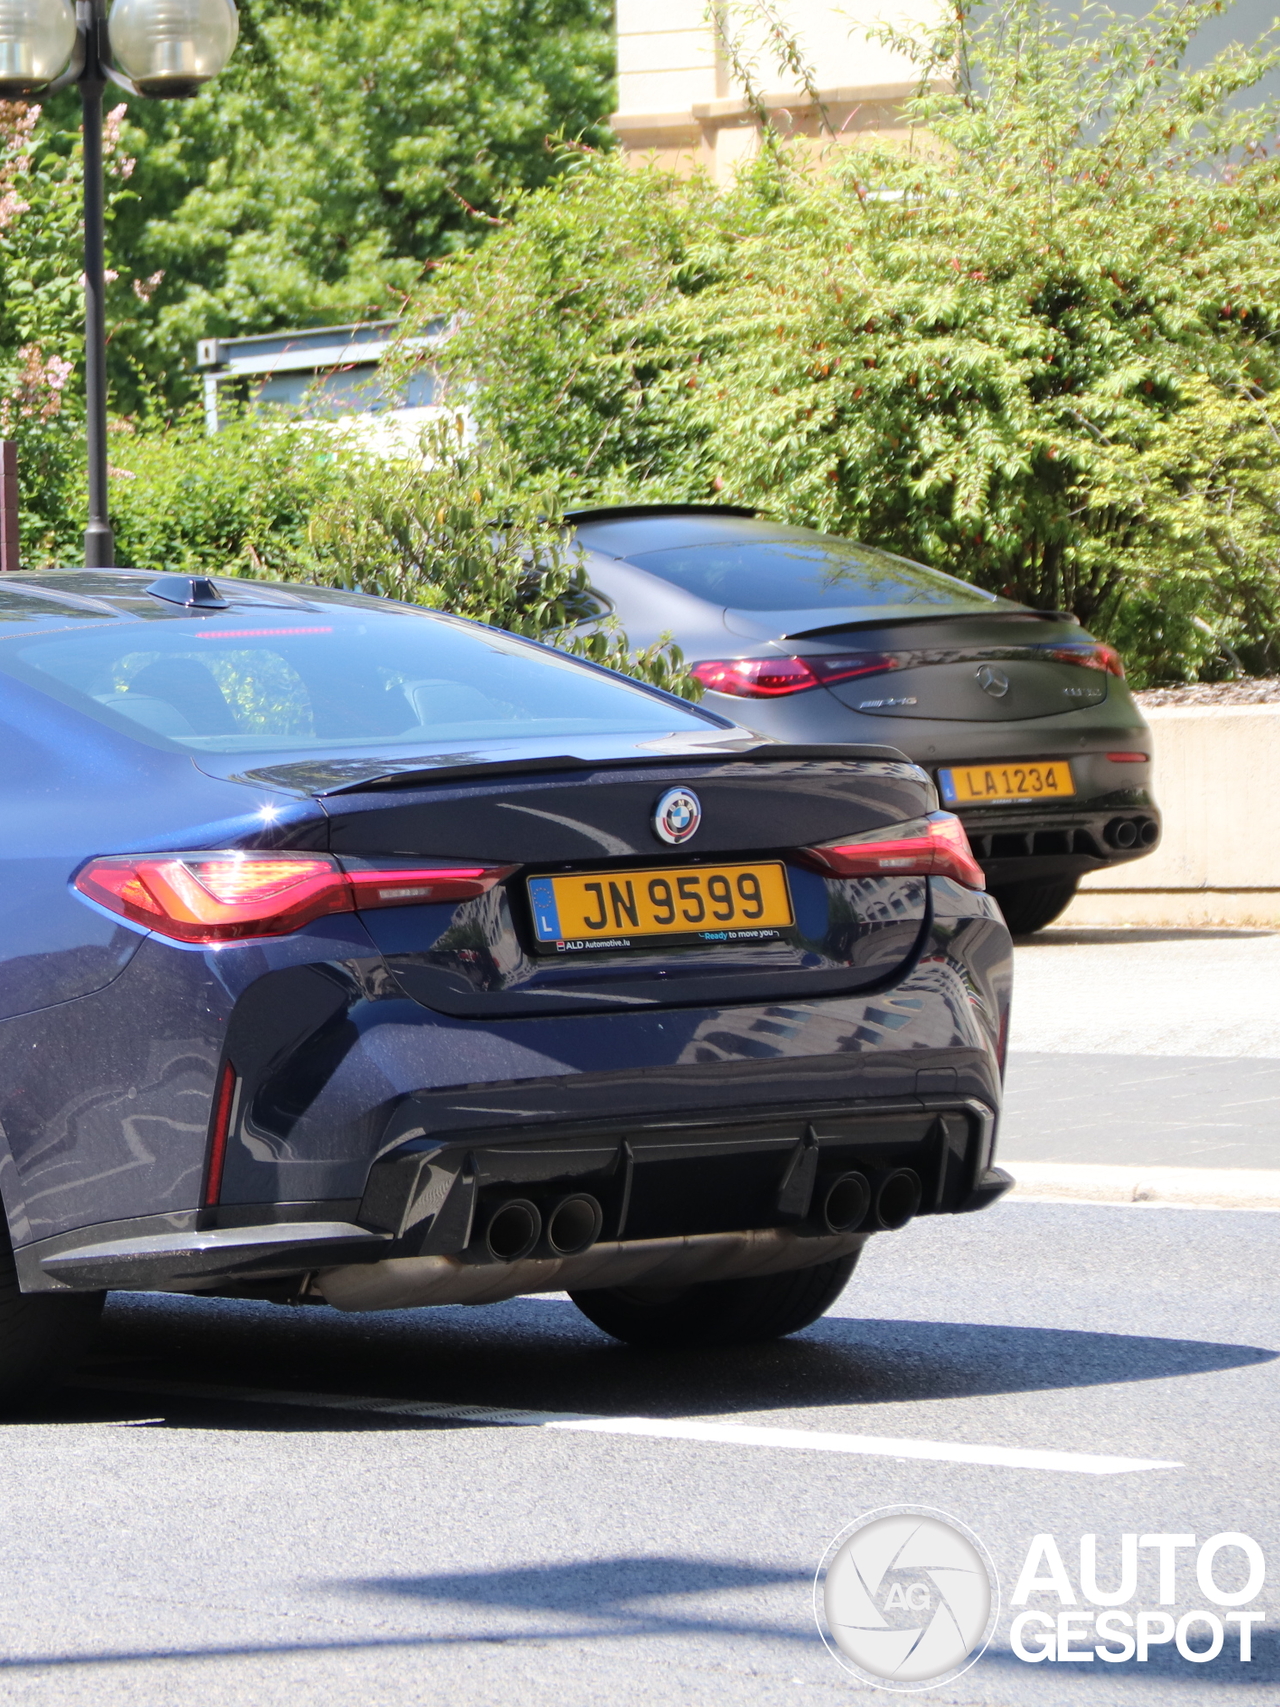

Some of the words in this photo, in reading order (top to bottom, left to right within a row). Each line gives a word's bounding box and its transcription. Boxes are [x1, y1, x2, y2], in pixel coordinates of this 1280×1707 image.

[583, 881, 640, 930] JN
[648, 873, 765, 925] 9599
[541, 916, 553, 932] L
[704, 931, 728, 940] Ready
[738, 930, 759, 938] move
[759, 929, 774, 938] you
[566, 941, 584, 950] ALD
[585, 938, 631, 949] Automotive.lu
